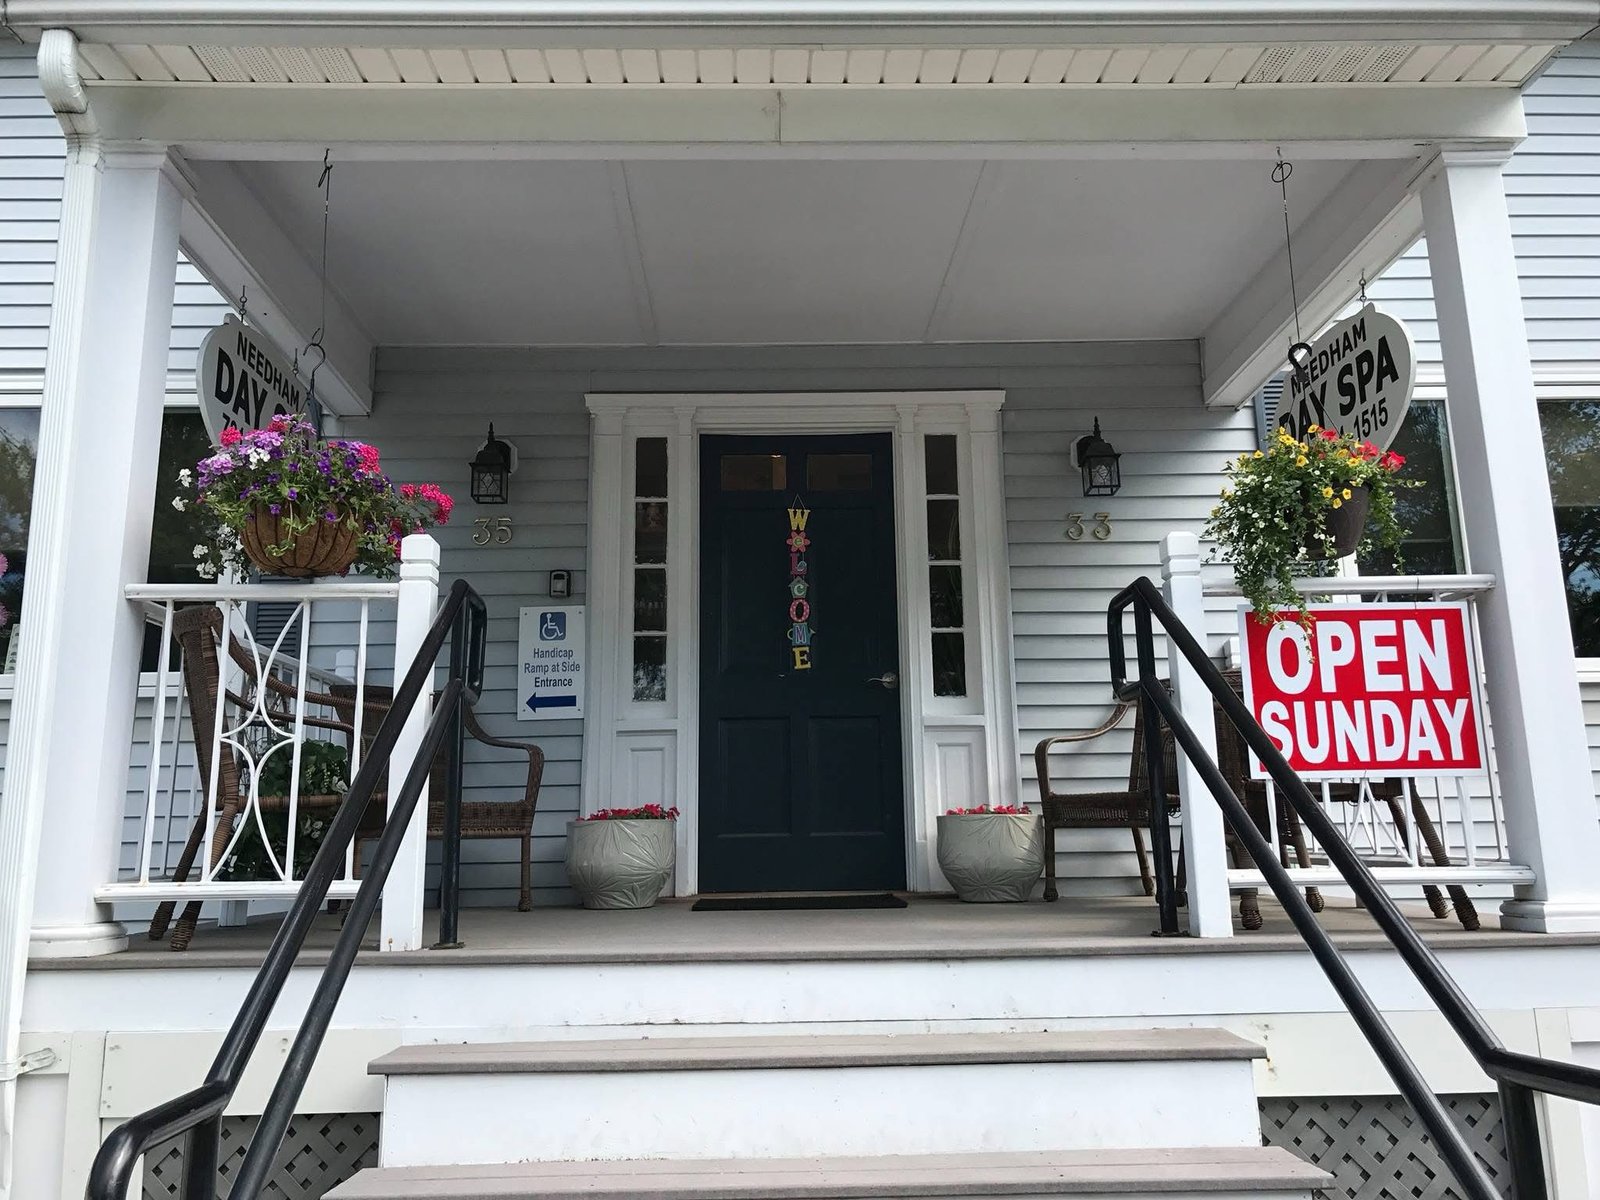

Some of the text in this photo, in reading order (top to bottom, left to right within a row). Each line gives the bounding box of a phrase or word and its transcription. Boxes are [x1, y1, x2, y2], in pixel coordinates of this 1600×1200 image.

[237, 330, 300, 412] NEEDHAM
[1290, 317, 1367, 398] NEEDHAM
[1337, 335, 1399, 417] SPA
[214, 346, 269, 430] DAY
[1353, 397, 1388, 442] 1515
[472, 517, 513, 546] 35
[1066, 512, 1113, 541] 33
[524, 661, 581, 675] Ramp at Side
[533, 647, 574, 660] Handicap
[1266, 619, 1453, 695] OPEN
[534, 676, 573, 688] Entrance
[1260, 698, 1469, 764] SUNDAY
